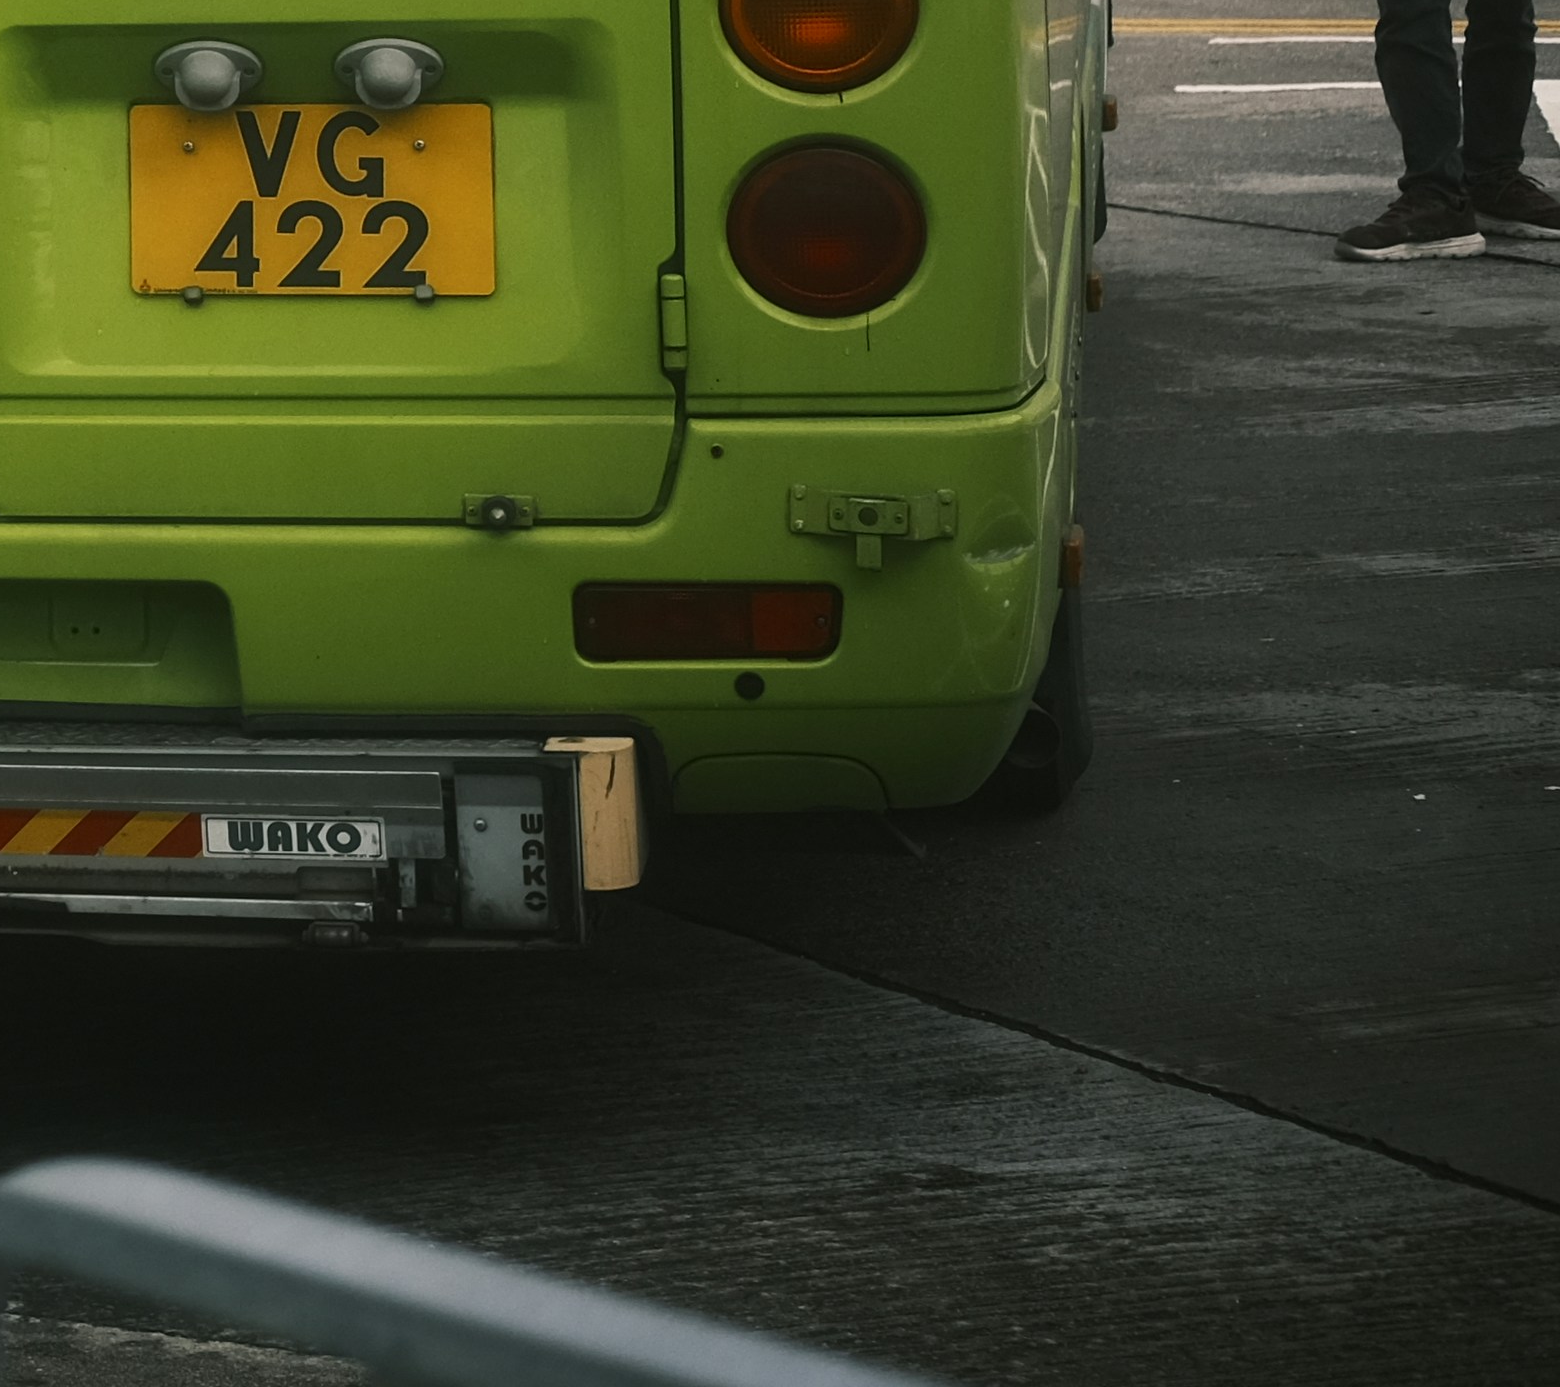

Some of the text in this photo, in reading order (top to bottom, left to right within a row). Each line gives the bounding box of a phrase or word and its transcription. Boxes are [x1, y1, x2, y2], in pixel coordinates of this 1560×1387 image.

[235, 110, 386, 200] VG
[193, 199, 431, 289] 422
[227, 820, 362, 854] WAKO
[520, 813, 548, 912] WAKO
